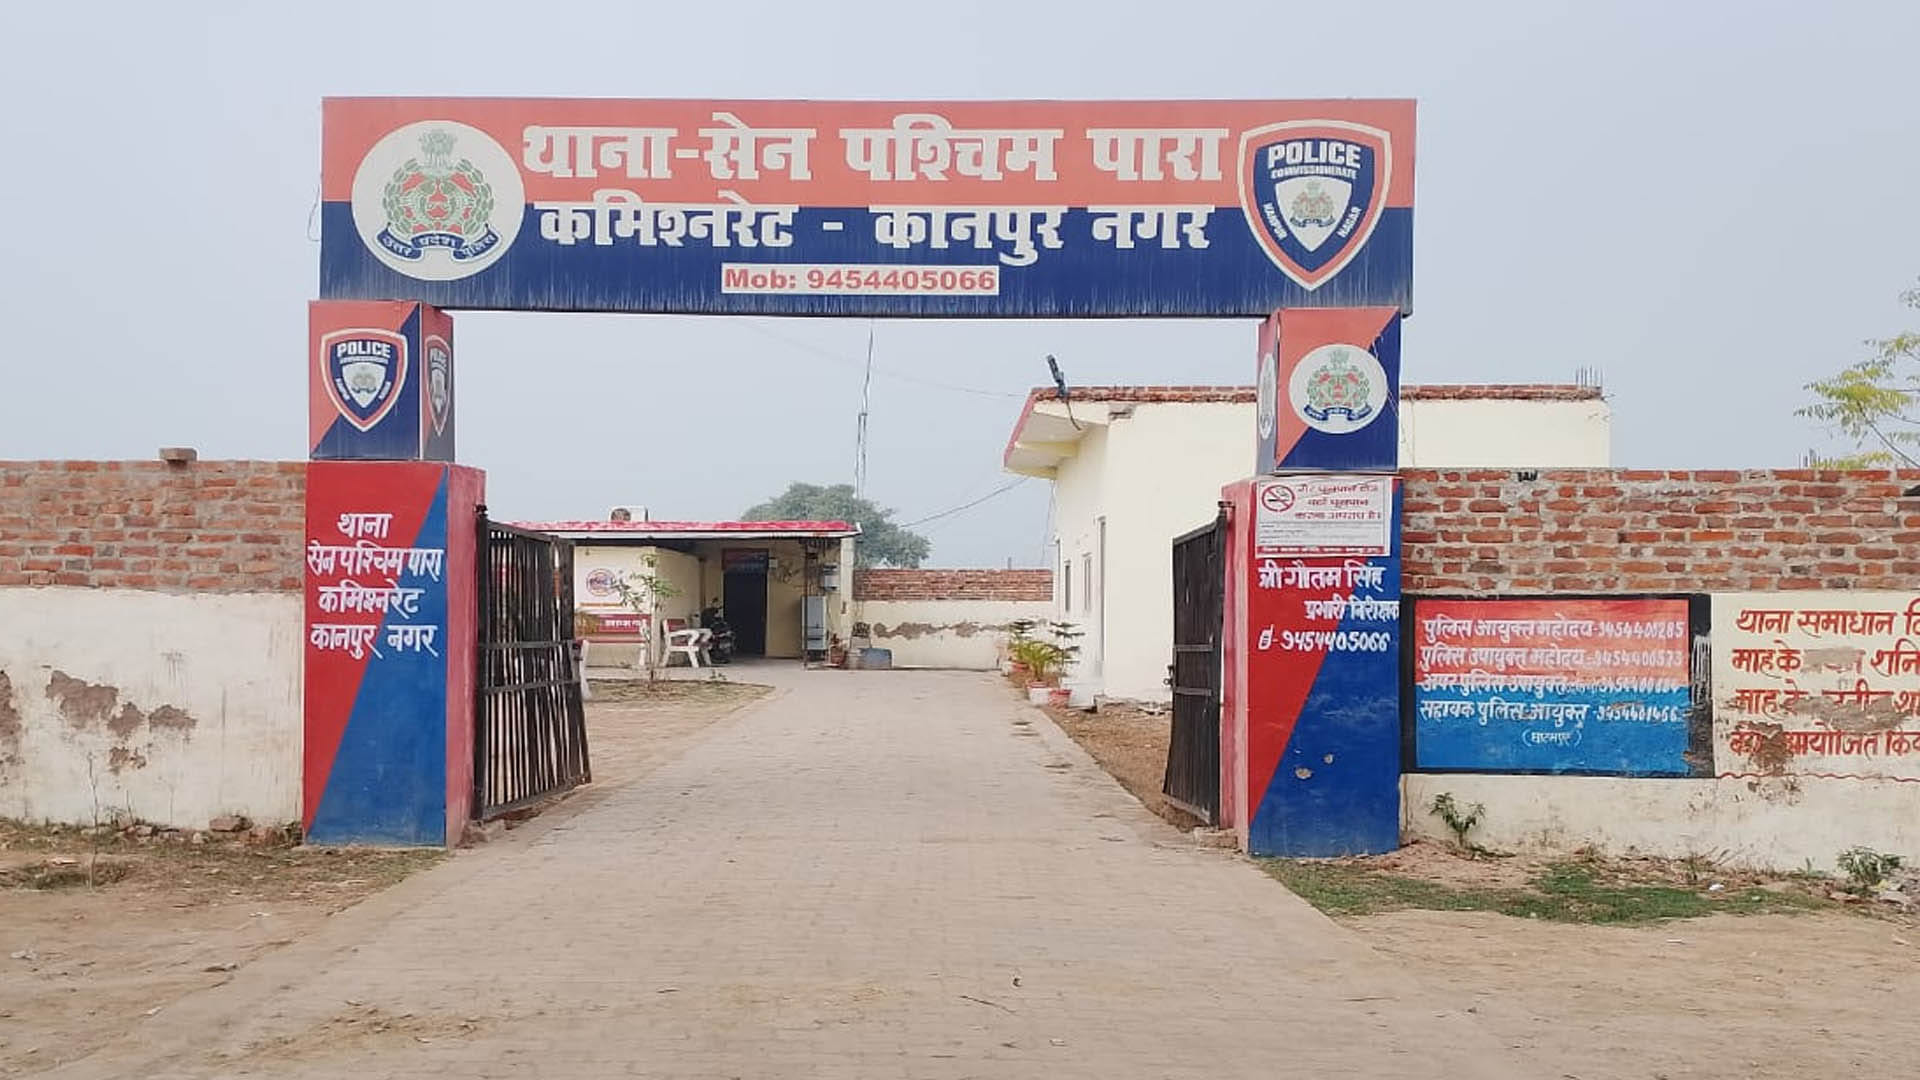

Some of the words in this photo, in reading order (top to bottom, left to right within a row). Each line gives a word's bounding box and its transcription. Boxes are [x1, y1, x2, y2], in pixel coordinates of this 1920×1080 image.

[839, 113, 1064, 181] पश्चिम
[1086, 129, 1229, 181] पारा
[1267, 141, 1361, 169] POLICE
[534, 189, 800, 247] कमिश्नरेट
[869, 205, 1068, 266] कानपुर
[1087, 205, 1216, 248] नगर
[724, 268, 796, 290] Mob:
[807, 269, 996, 291] 9454405066
[336, 340, 392, 359] POLICE
[337, 513, 394, 539] थाना
[307, 540, 336, 576] सेन
[340, 540, 405, 577] पश्चिम
[407, 548, 445, 582] पारा
[1258, 560, 1283, 589] श्री
[1284, 559, 1342, 590] गौतम
[1344, 559, 1387, 592] सिंह
[318, 578, 425, 619] कमिश्नरेट
[1421, 613, 1473, 643] पुलिस
[1474, 619, 1536, 643] आयुक्त
[1735, 609, 1795, 634] थाना
[1797, 610, 1898, 638] समाधान
[310, 623, 384, 659] कानपुर
[387, 624, 439, 658] नगर
[1420, 642, 1467, 671] पुलिस
[1731, 648, 1780, 679] माह
[1775, 639, 1801, 673] के
[1420, 699, 1475, 722] सहायक
[1477, 697, 1525, 725] पुलिस
[1735, 689, 1782, 720] माह
